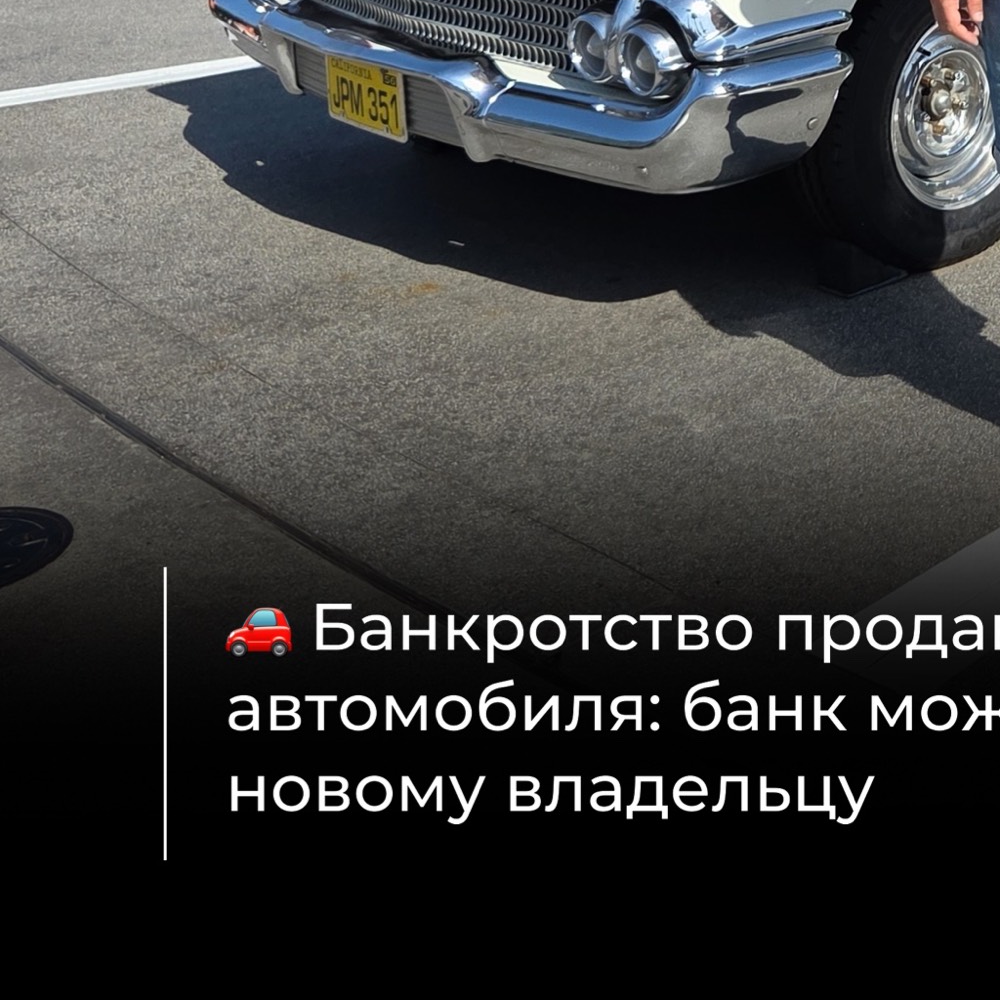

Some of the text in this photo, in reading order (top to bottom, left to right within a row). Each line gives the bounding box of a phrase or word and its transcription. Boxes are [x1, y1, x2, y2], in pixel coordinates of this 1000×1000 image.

[331, 57, 372, 80] CALIFORNIA
[333, 75, 399, 129] JPM 351
